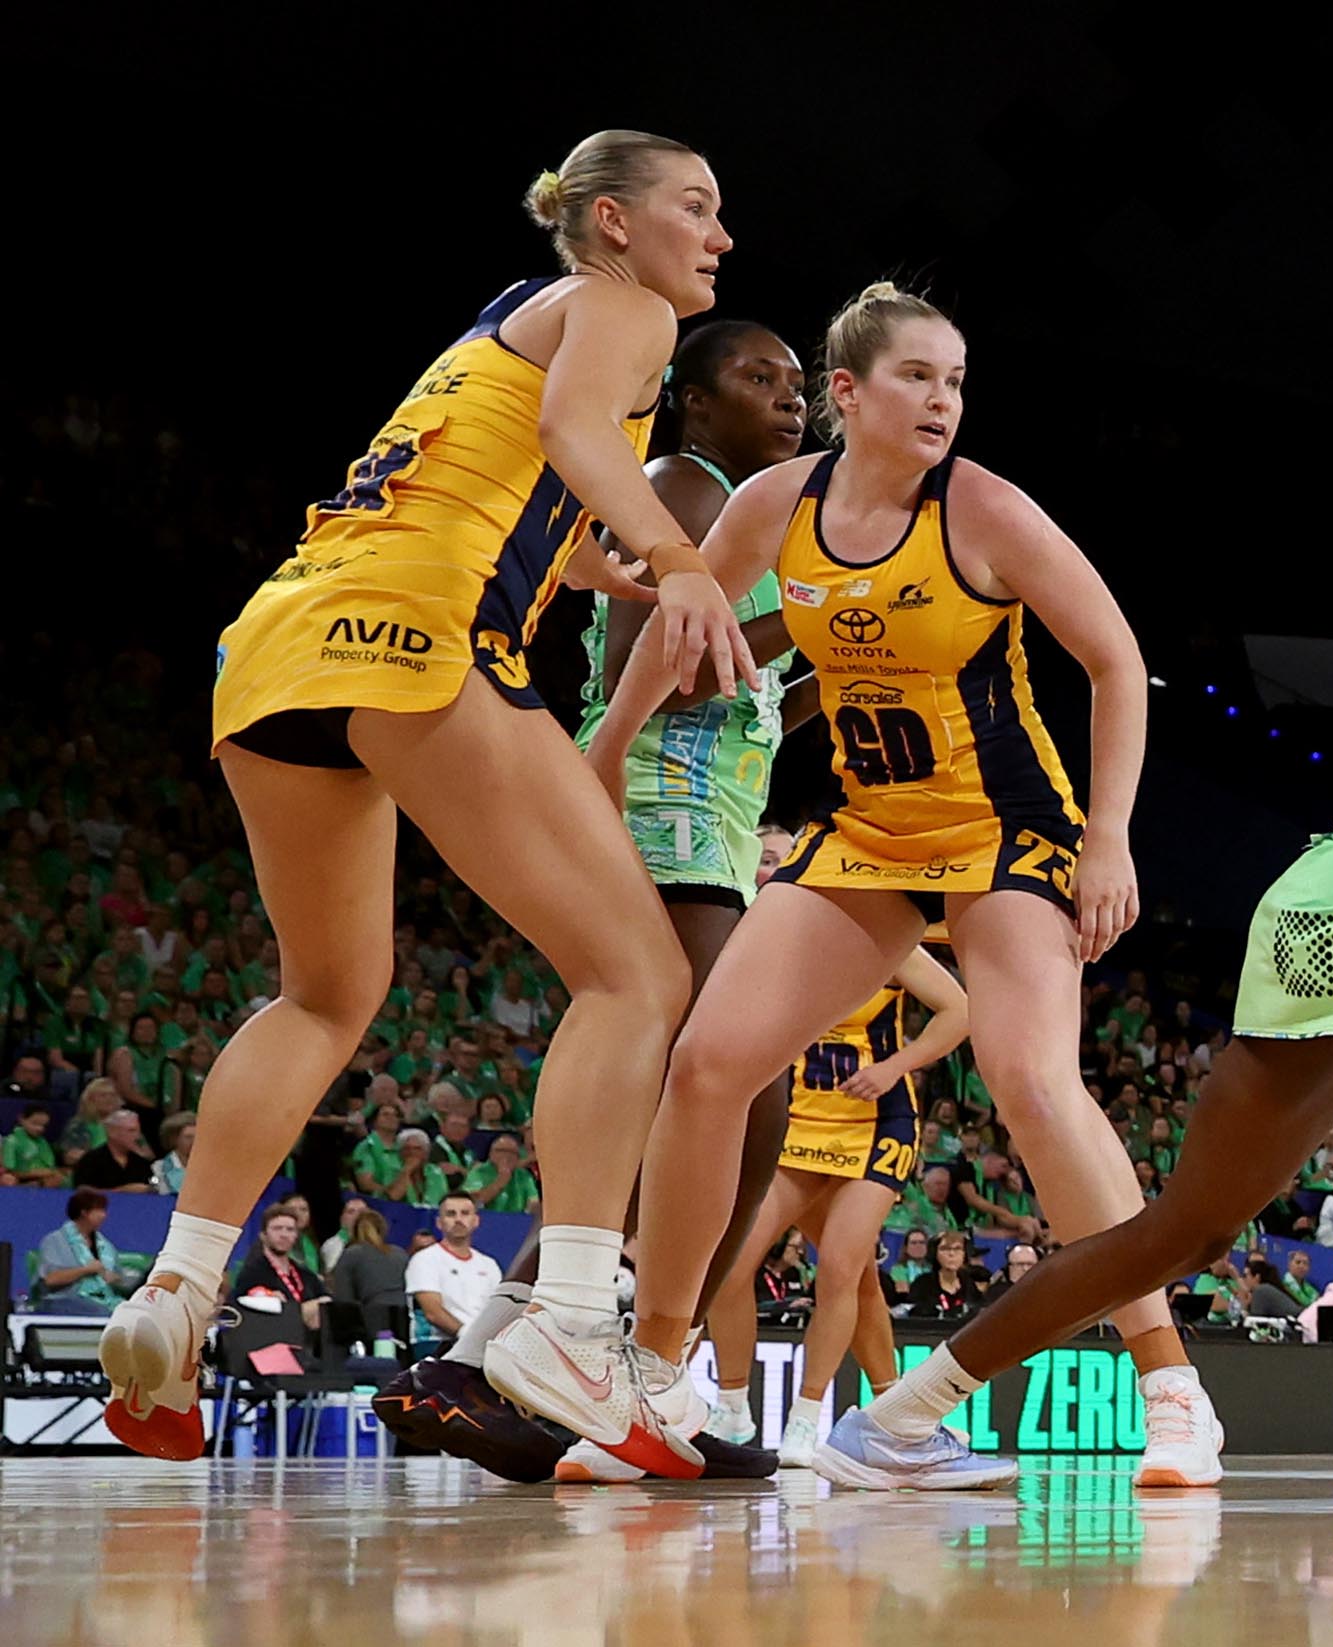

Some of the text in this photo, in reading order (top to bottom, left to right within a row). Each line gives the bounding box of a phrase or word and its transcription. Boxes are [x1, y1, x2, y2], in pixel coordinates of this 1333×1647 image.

[325, 618, 432, 654] AVID
[830, 646, 897, 659] TOYOTA
[321, 647, 427, 673] Property Group
[840, 692, 903, 704] carsales
[835, 705, 936, 788] GD
[1009, 829, 1077, 899] 23
[873, 1138, 913, 1181] 20
